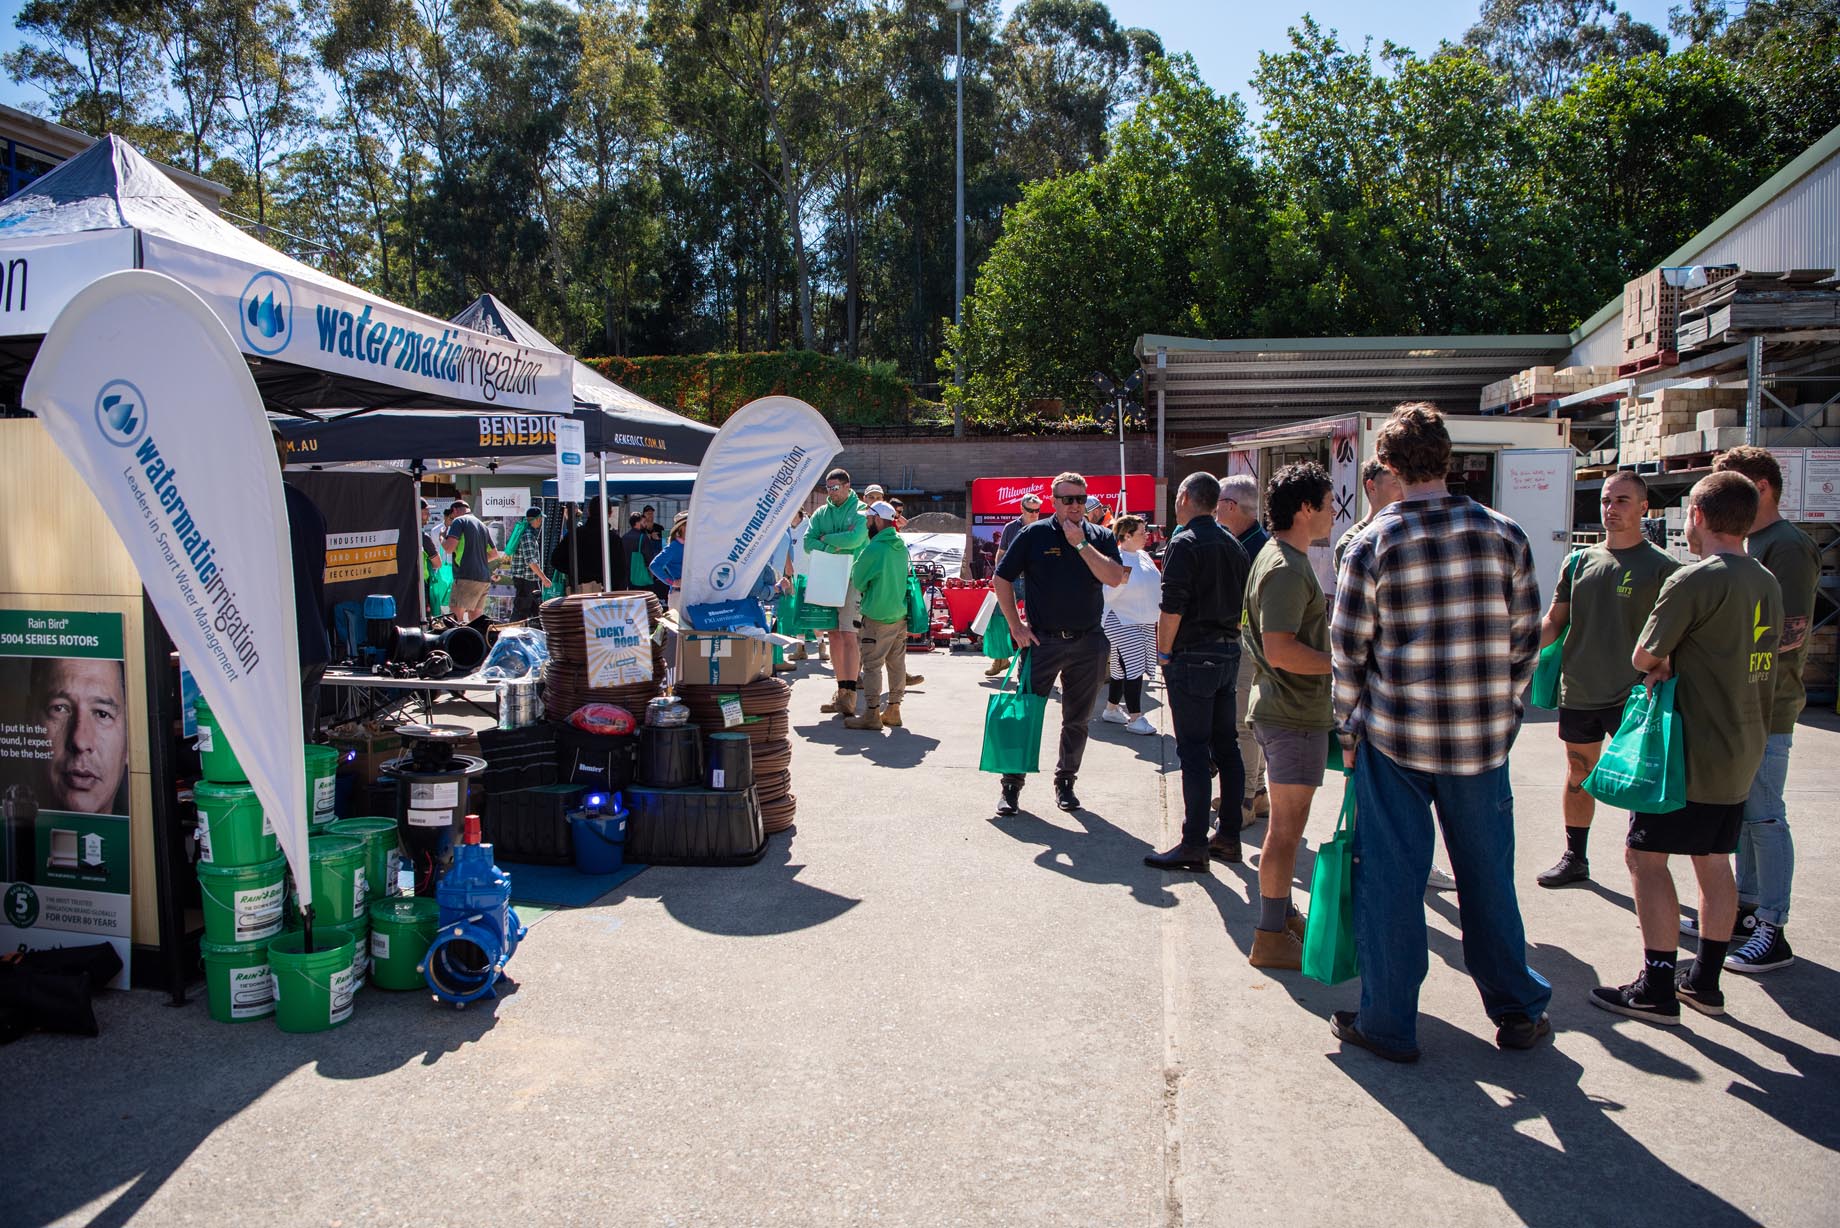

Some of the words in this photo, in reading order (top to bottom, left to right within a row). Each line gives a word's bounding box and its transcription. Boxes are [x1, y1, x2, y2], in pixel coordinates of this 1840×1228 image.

[316, 303, 543, 402] watermaticirrigation
[479, 416, 557, 446] BENEDIC
[614, 433, 667, 450] BENEDICT.COM.AU
[996, 483, 1045, 501] Milwaukee
[485, 496, 515, 508] cinajus
[727, 445, 806, 564] watermaticirrigation
[329, 535, 377, 546] INDUSTRIES
[134, 435, 260, 675] watermaticirrigation
[123, 466, 152, 520] Leaders
[148, 517, 160, 534] in
[155, 532, 180, 573] Smart
[175, 568, 198, 607] Water
[192, 606, 239, 683] Management
[329, 567, 372, 579] RECYCLING
[27, 618, 46, 629] Rain
[595, 626, 625, 639] LUCKY
[1, 633, 24, 644] 5004
[25, 634, 58, 645] SERIES
[59, 635, 99, 647] ROTORS
[613, 636, 640, 648] DOOR
[5, 724, 18, 734] put
[19, 724, 25, 733] it
[26, 724, 34, 733] in
[34, 725, 48, 734] the
[0, 736, 22, 746] ound,
[27, 739, 53, 748] expect
[1, 749, 9, 757] to
[10, 748, 20, 758] be
[21, 749, 34, 758] the
[16, 892, 28, 914] 5
[240, 893, 262, 904] RAIN
[46, 912, 60, 922] FOR
[61, 914, 82, 924] OVER
[92, 918, 117, 928] YEARS
[235, 972, 258, 981] RAIN
